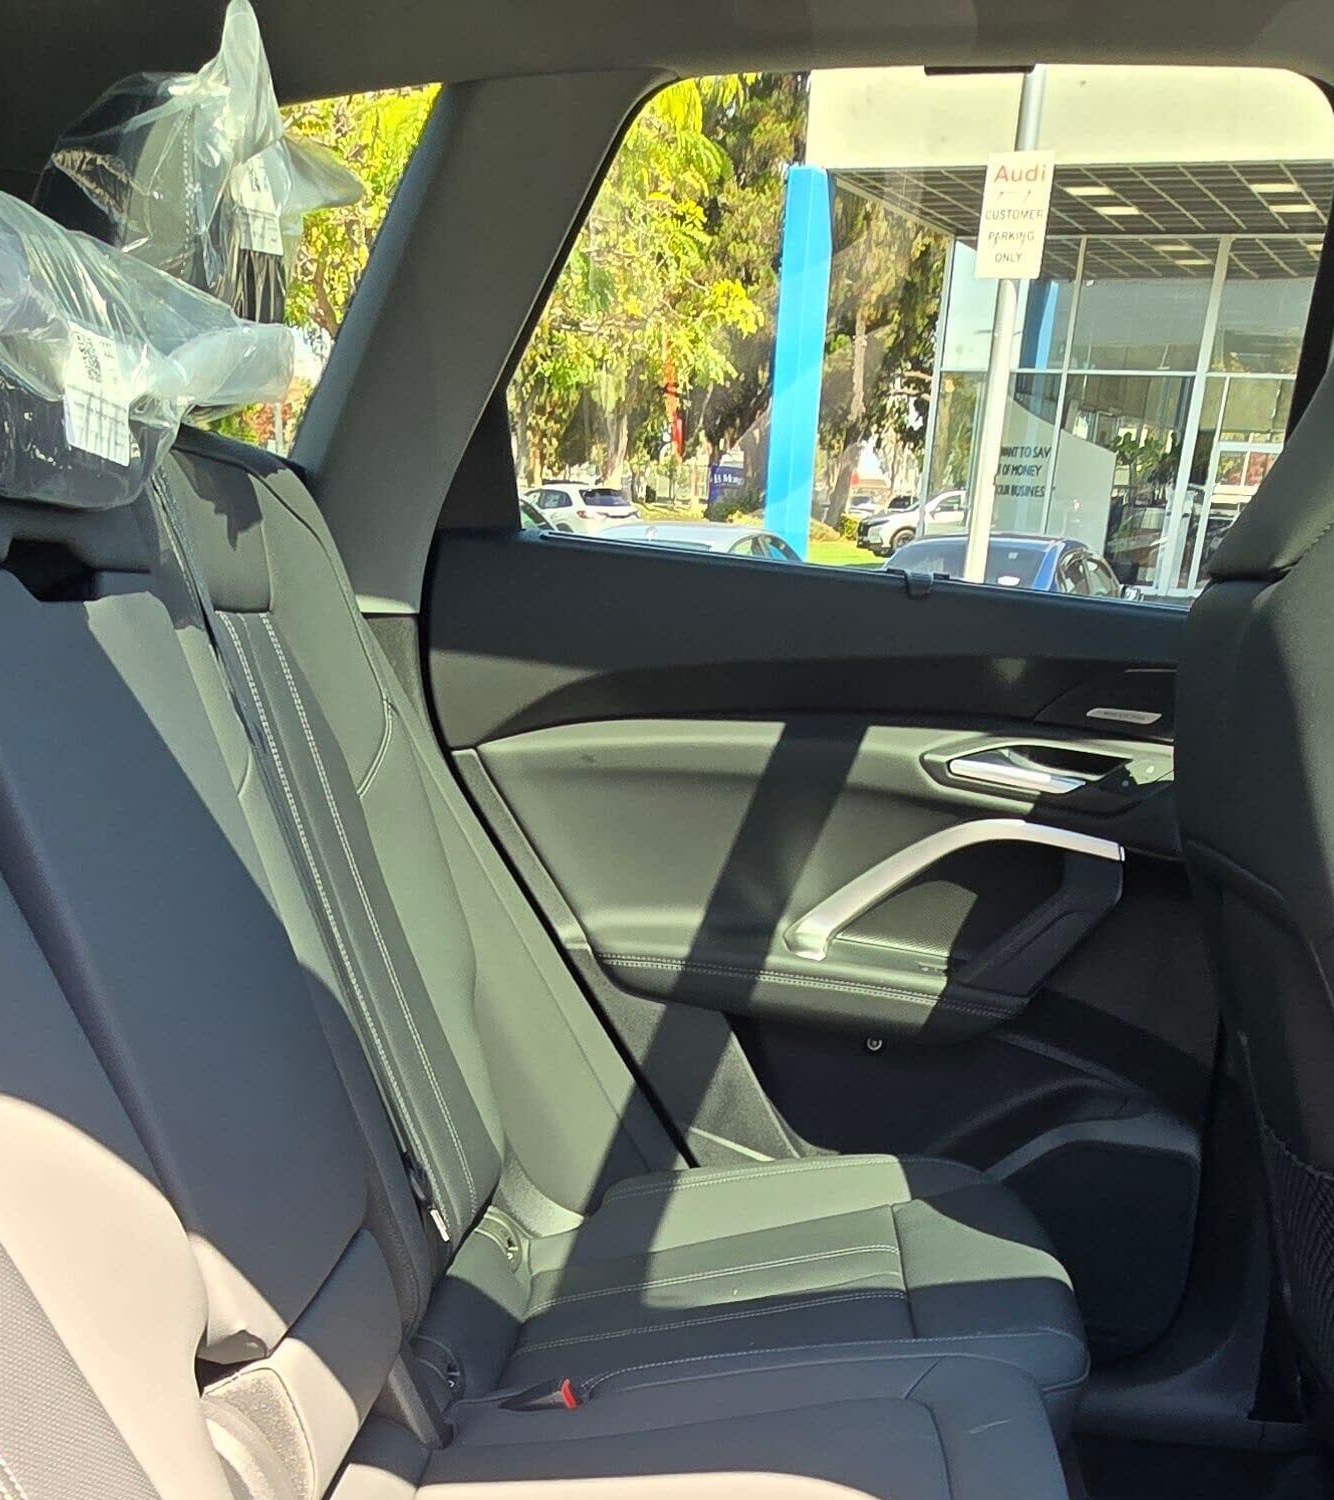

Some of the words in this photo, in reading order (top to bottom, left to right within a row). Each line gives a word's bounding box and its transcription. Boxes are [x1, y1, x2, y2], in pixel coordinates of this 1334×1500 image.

[993, 164, 1046, 182] Audi
[985, 208, 1043, 220] CUSTOMER
[988, 230, 1035, 241] PARKING
[994, 252, 1023, 263] ONLY
[1019, 446, 1032, 458] TO
[1011, 464, 1042, 476] MONEY
[1011, 484, 1051, 497] BUSINES
